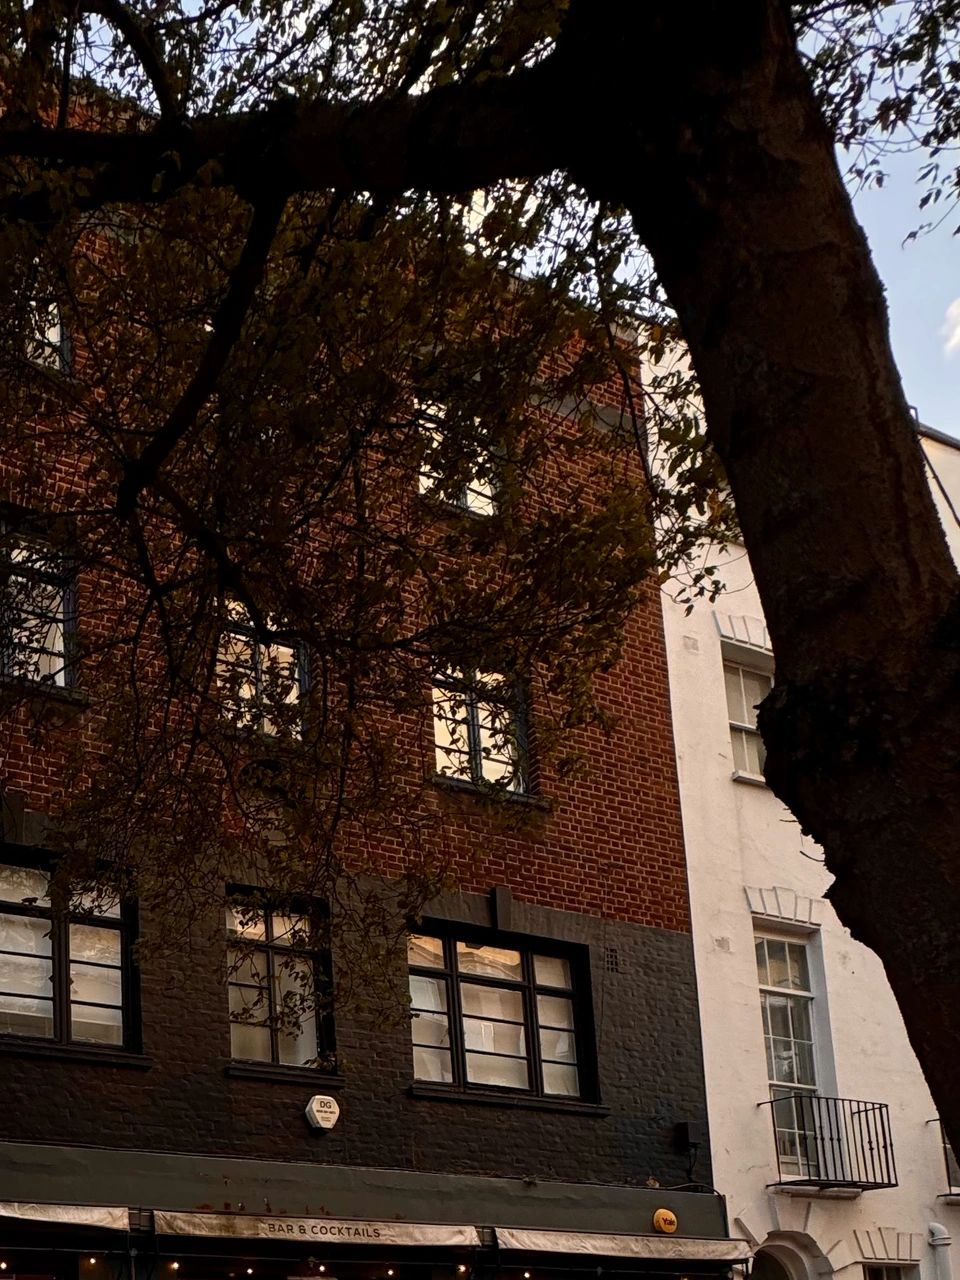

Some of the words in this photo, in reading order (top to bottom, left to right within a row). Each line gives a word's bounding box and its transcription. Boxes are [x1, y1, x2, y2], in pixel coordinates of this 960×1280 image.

[320, 1101, 332, 1109] DG
[268, 1223, 294, 1234] BAR
[298, 1225, 307, 1235] &
[311, 1225, 381, 1238] COCKTAILS
